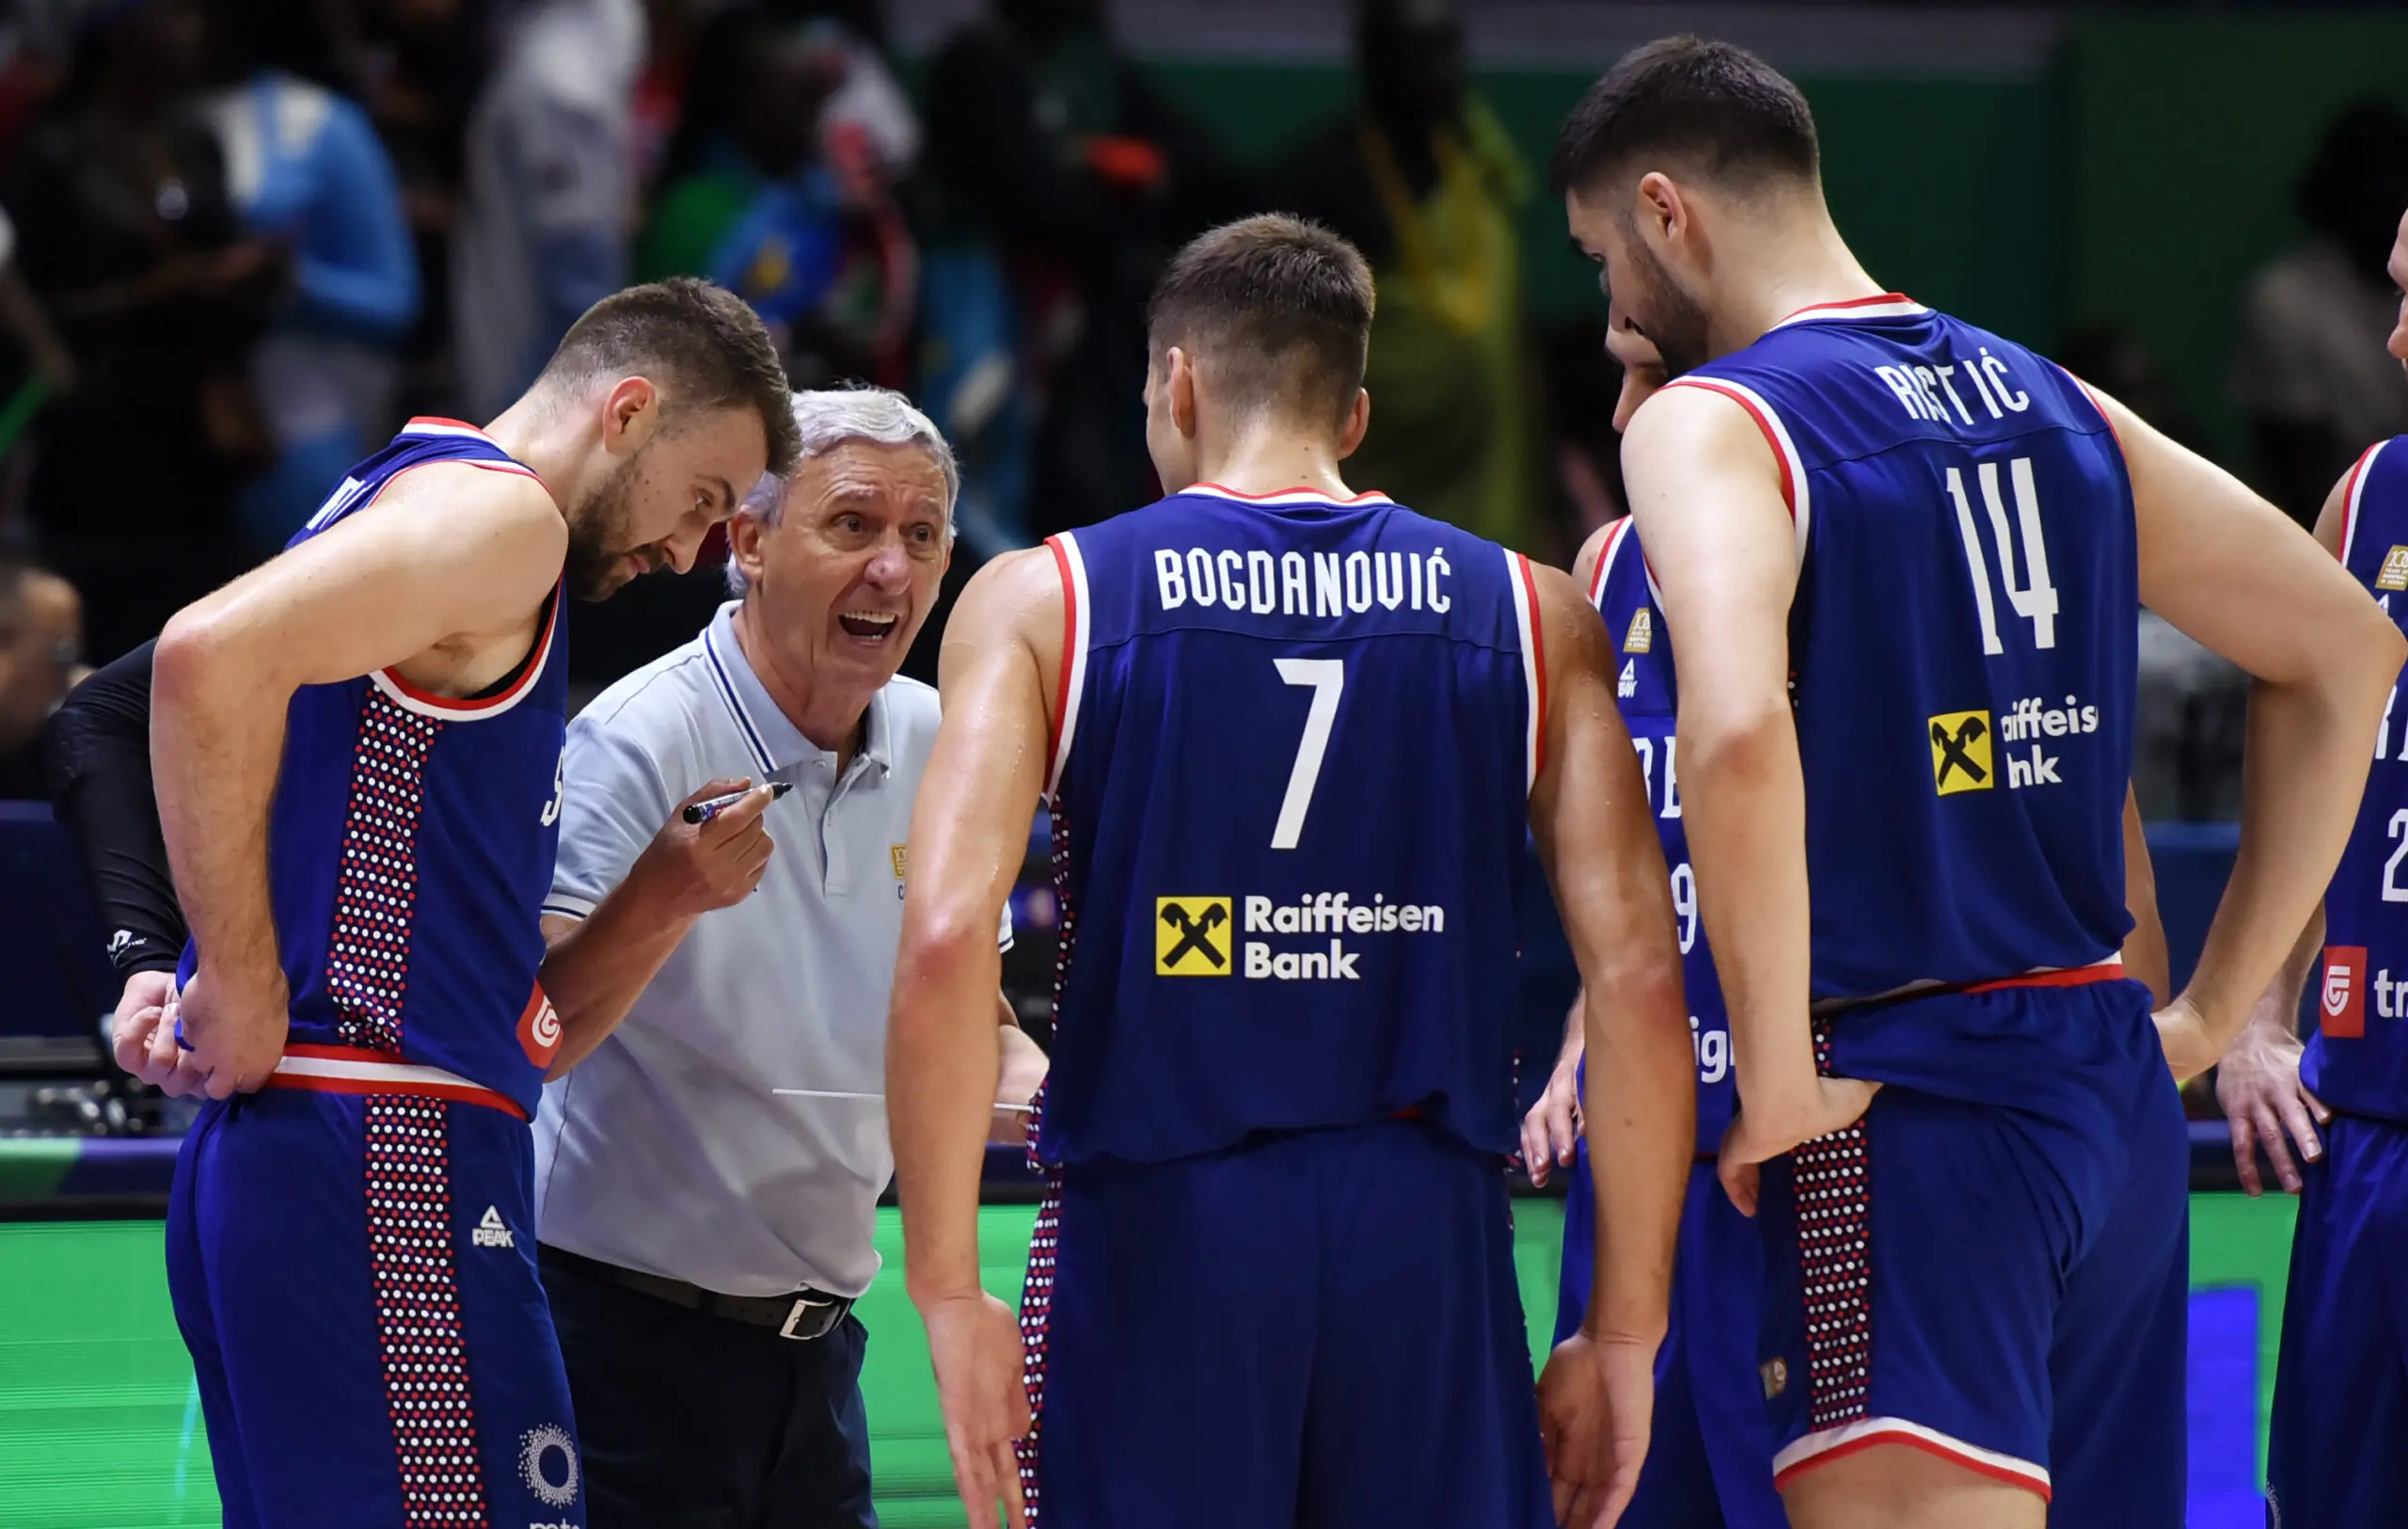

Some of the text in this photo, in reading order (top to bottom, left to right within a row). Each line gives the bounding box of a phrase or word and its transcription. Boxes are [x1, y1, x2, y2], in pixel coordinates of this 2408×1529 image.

[1154, 547, 1451, 617] BOGDANOVIĆ
[1946, 457, 2059, 656] 14
[1271, 659, 1344, 850] 7
[1244, 893, 1444, 933] Raiffeisen
[1244, 939, 1361, 980] Bank
[472, 1228, 515, 1248] PEAK
